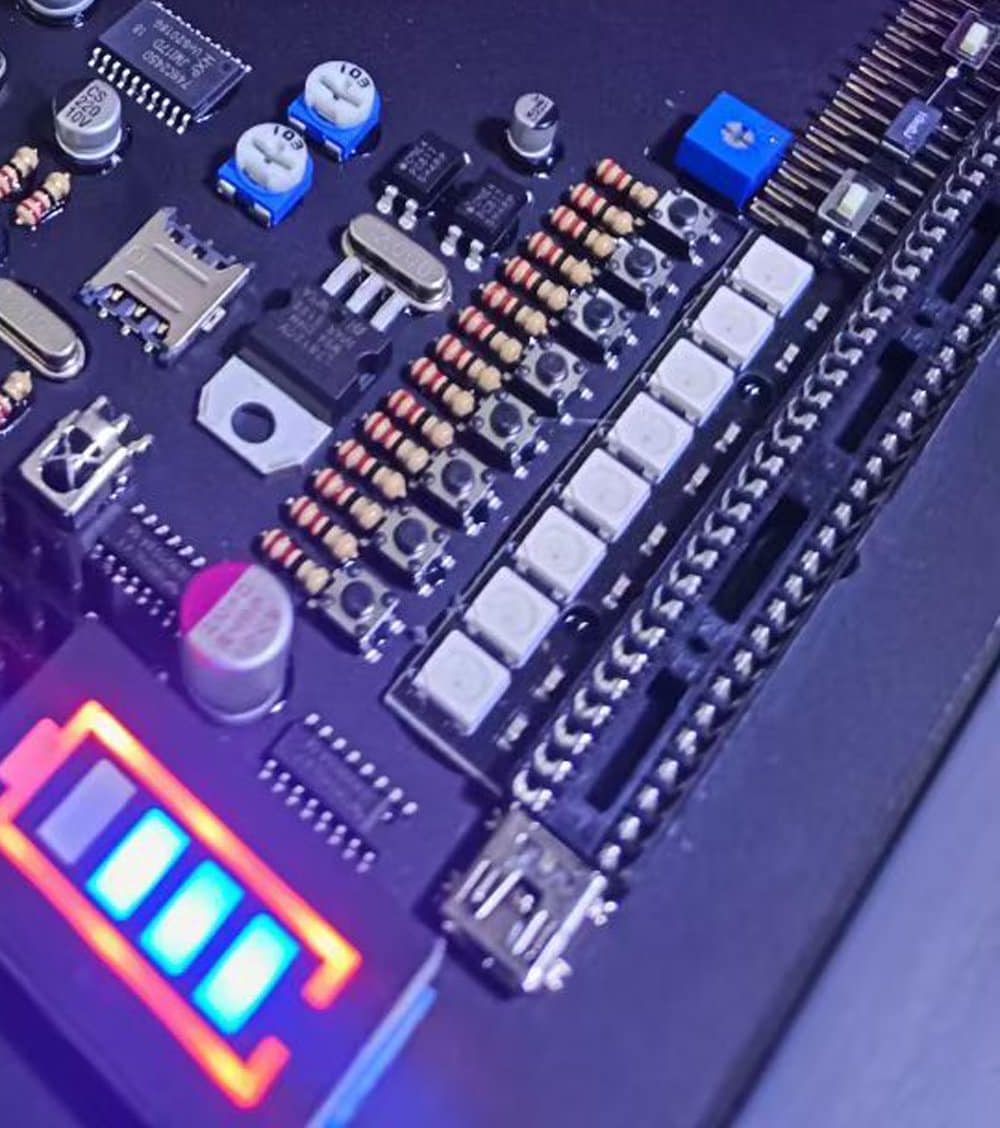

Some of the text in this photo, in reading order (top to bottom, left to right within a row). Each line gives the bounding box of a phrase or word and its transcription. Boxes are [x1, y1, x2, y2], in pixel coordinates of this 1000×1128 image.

[340, 63, 371, 89] 103
[86, 86, 107, 103] CS
[66, 106, 92, 128] 10V
[75, 96, 101, 118] 220
[273, 125, 305, 151] 103
